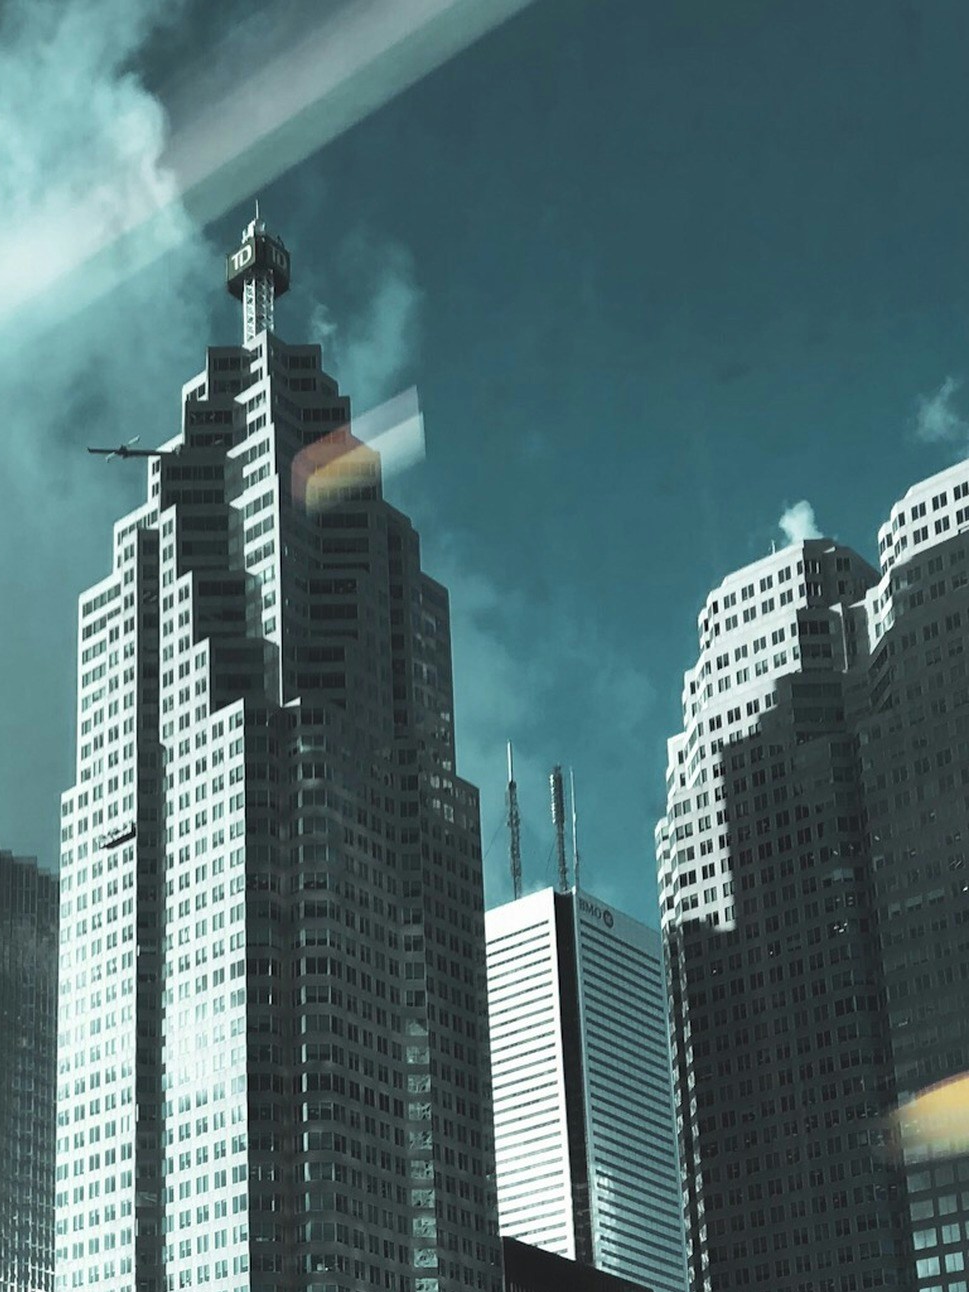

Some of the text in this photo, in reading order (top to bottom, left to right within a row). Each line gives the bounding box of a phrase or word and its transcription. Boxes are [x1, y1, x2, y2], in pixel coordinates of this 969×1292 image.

[231, 244, 252, 271] TD
[269, 244, 288, 270] TD
[578, 898, 602, 920] BMO
